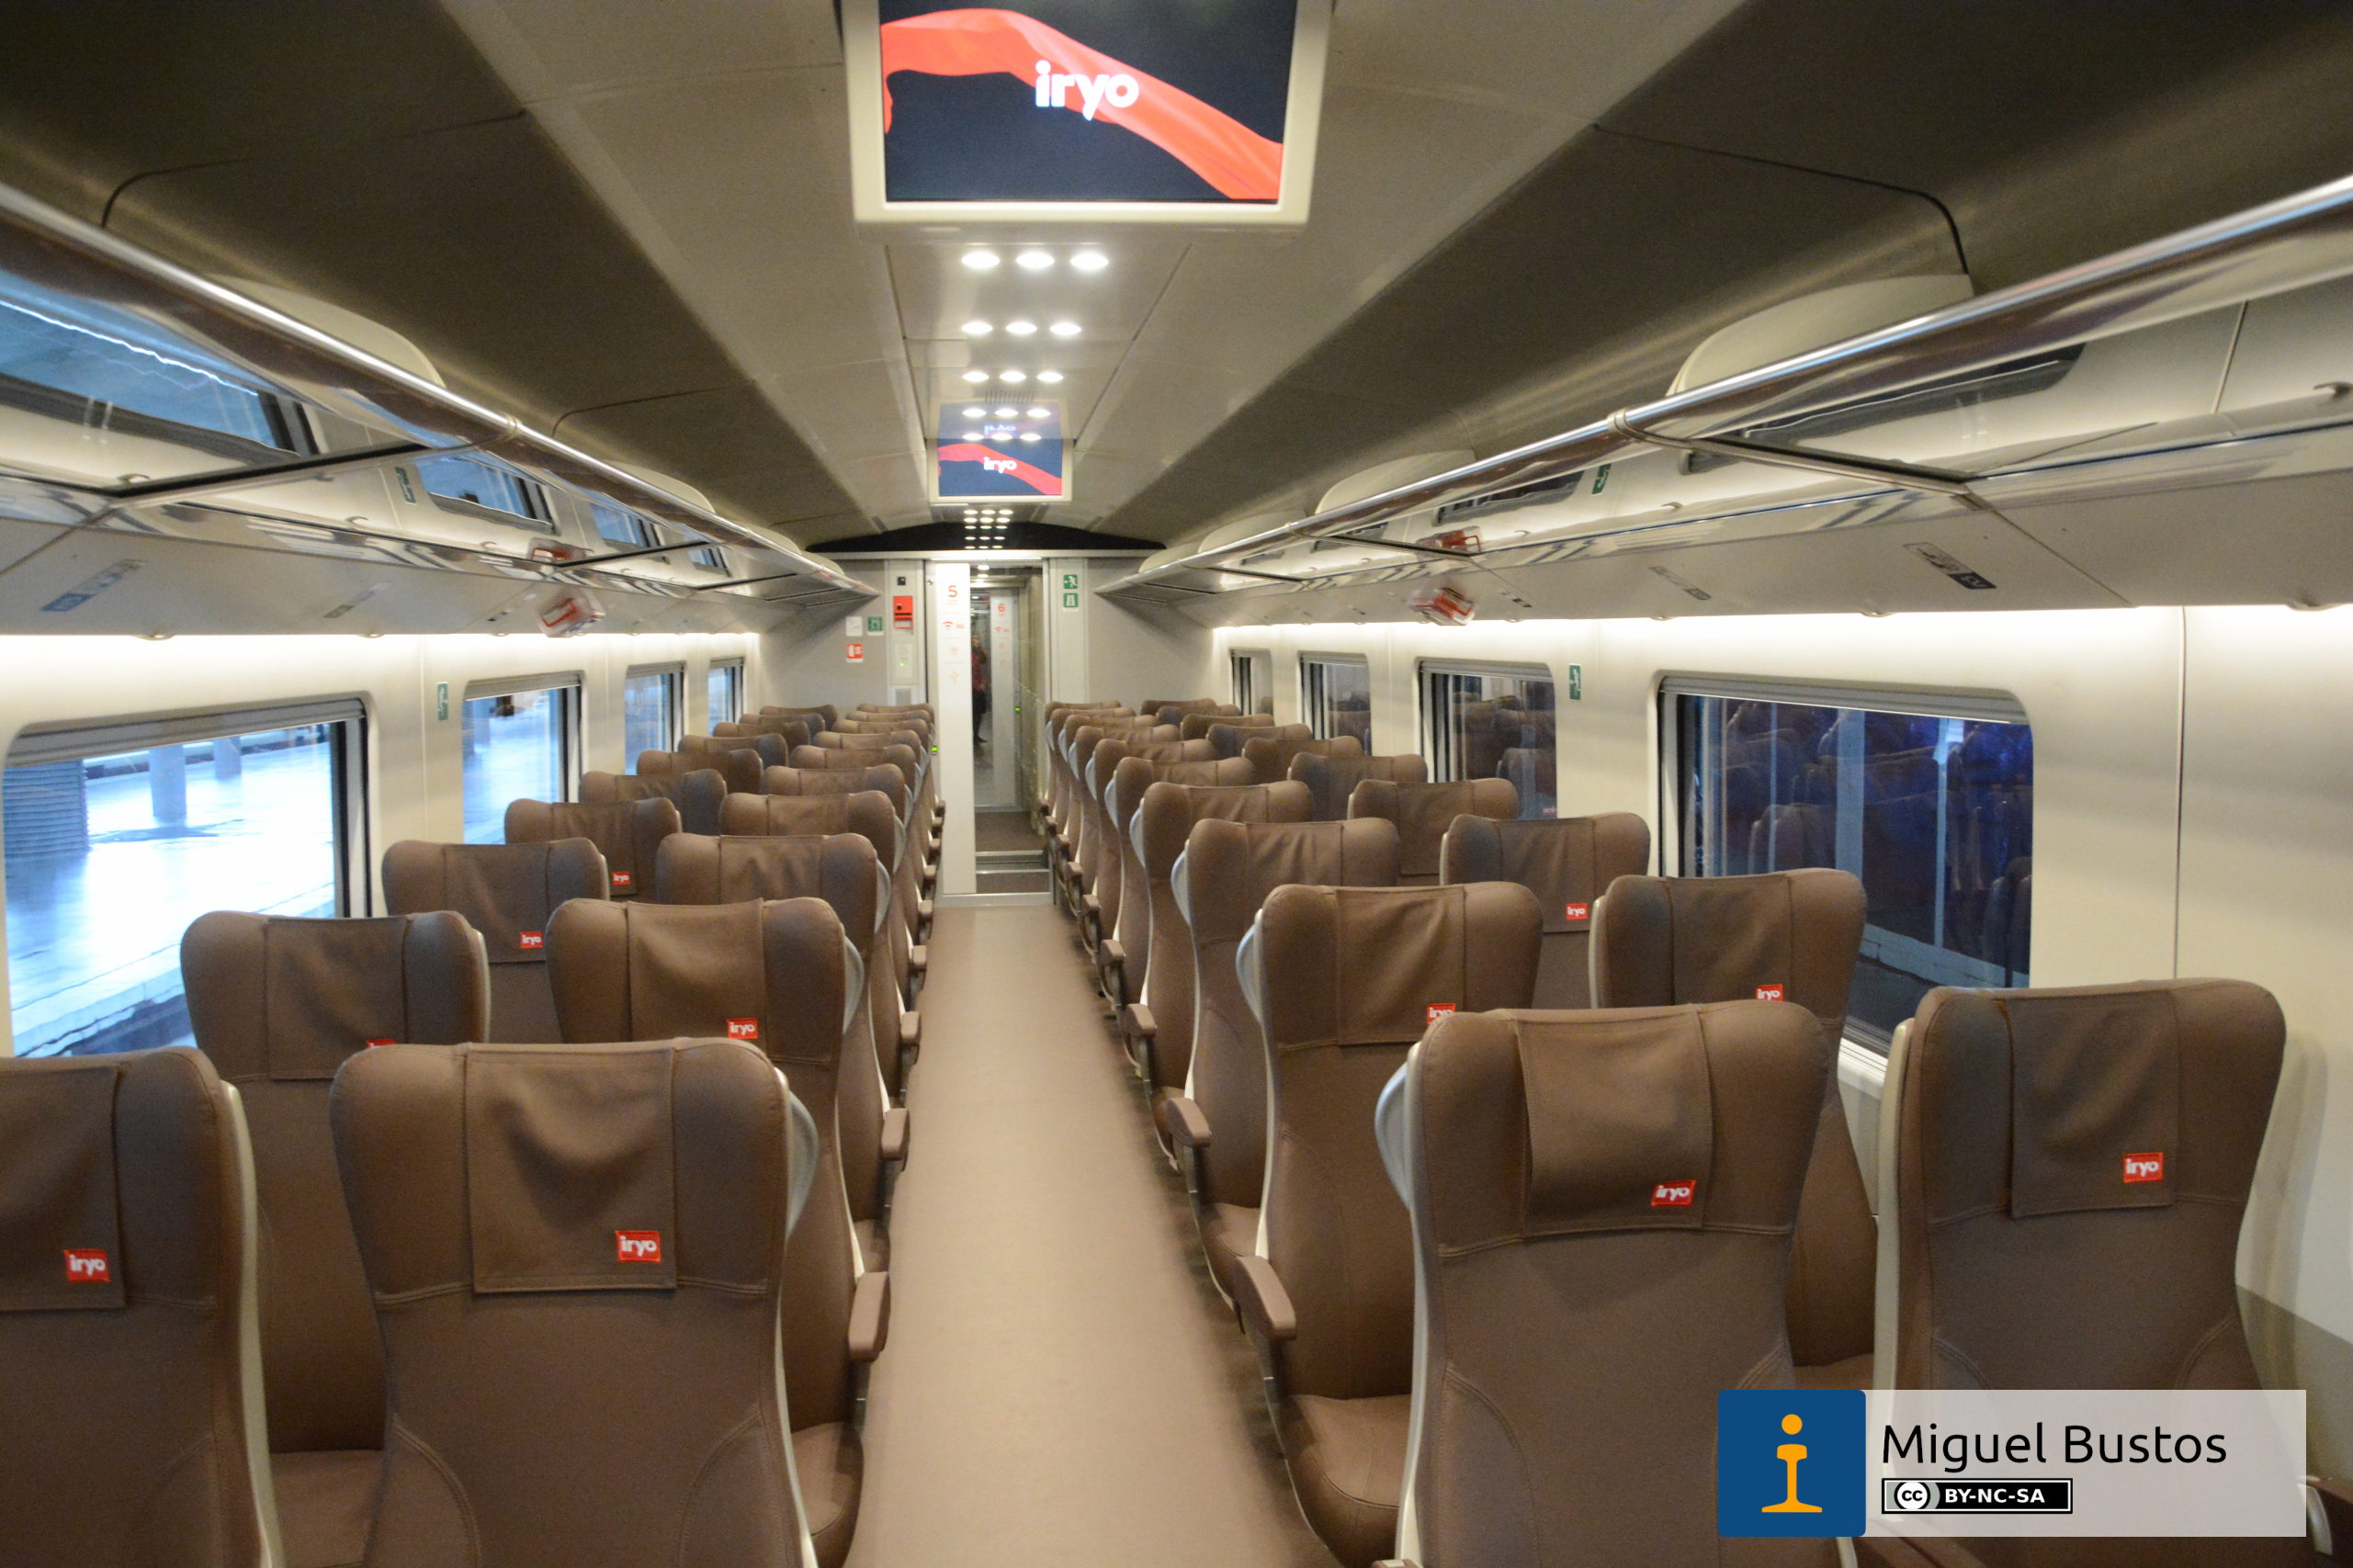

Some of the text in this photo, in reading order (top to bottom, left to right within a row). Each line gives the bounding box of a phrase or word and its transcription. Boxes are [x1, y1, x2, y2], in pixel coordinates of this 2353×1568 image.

[1035, 60, 1139, 121] iryo
[983, 457, 1017, 473] iryo
[948, 585, 957, 597] 5
[998, 603, 1005, 612] 6
[1567, 906, 1586, 917] iryo
[522, 935, 541, 945] iryo
[1757, 988, 1781, 1000] iryo
[730, 1021, 755, 1036] iryo
[2125, 1158, 2159, 1177] iryo
[1656, 1185, 1691, 1201] iryo
[619, 1235, 657, 1257] iryo
[69, 1254, 106, 1276] iryo
